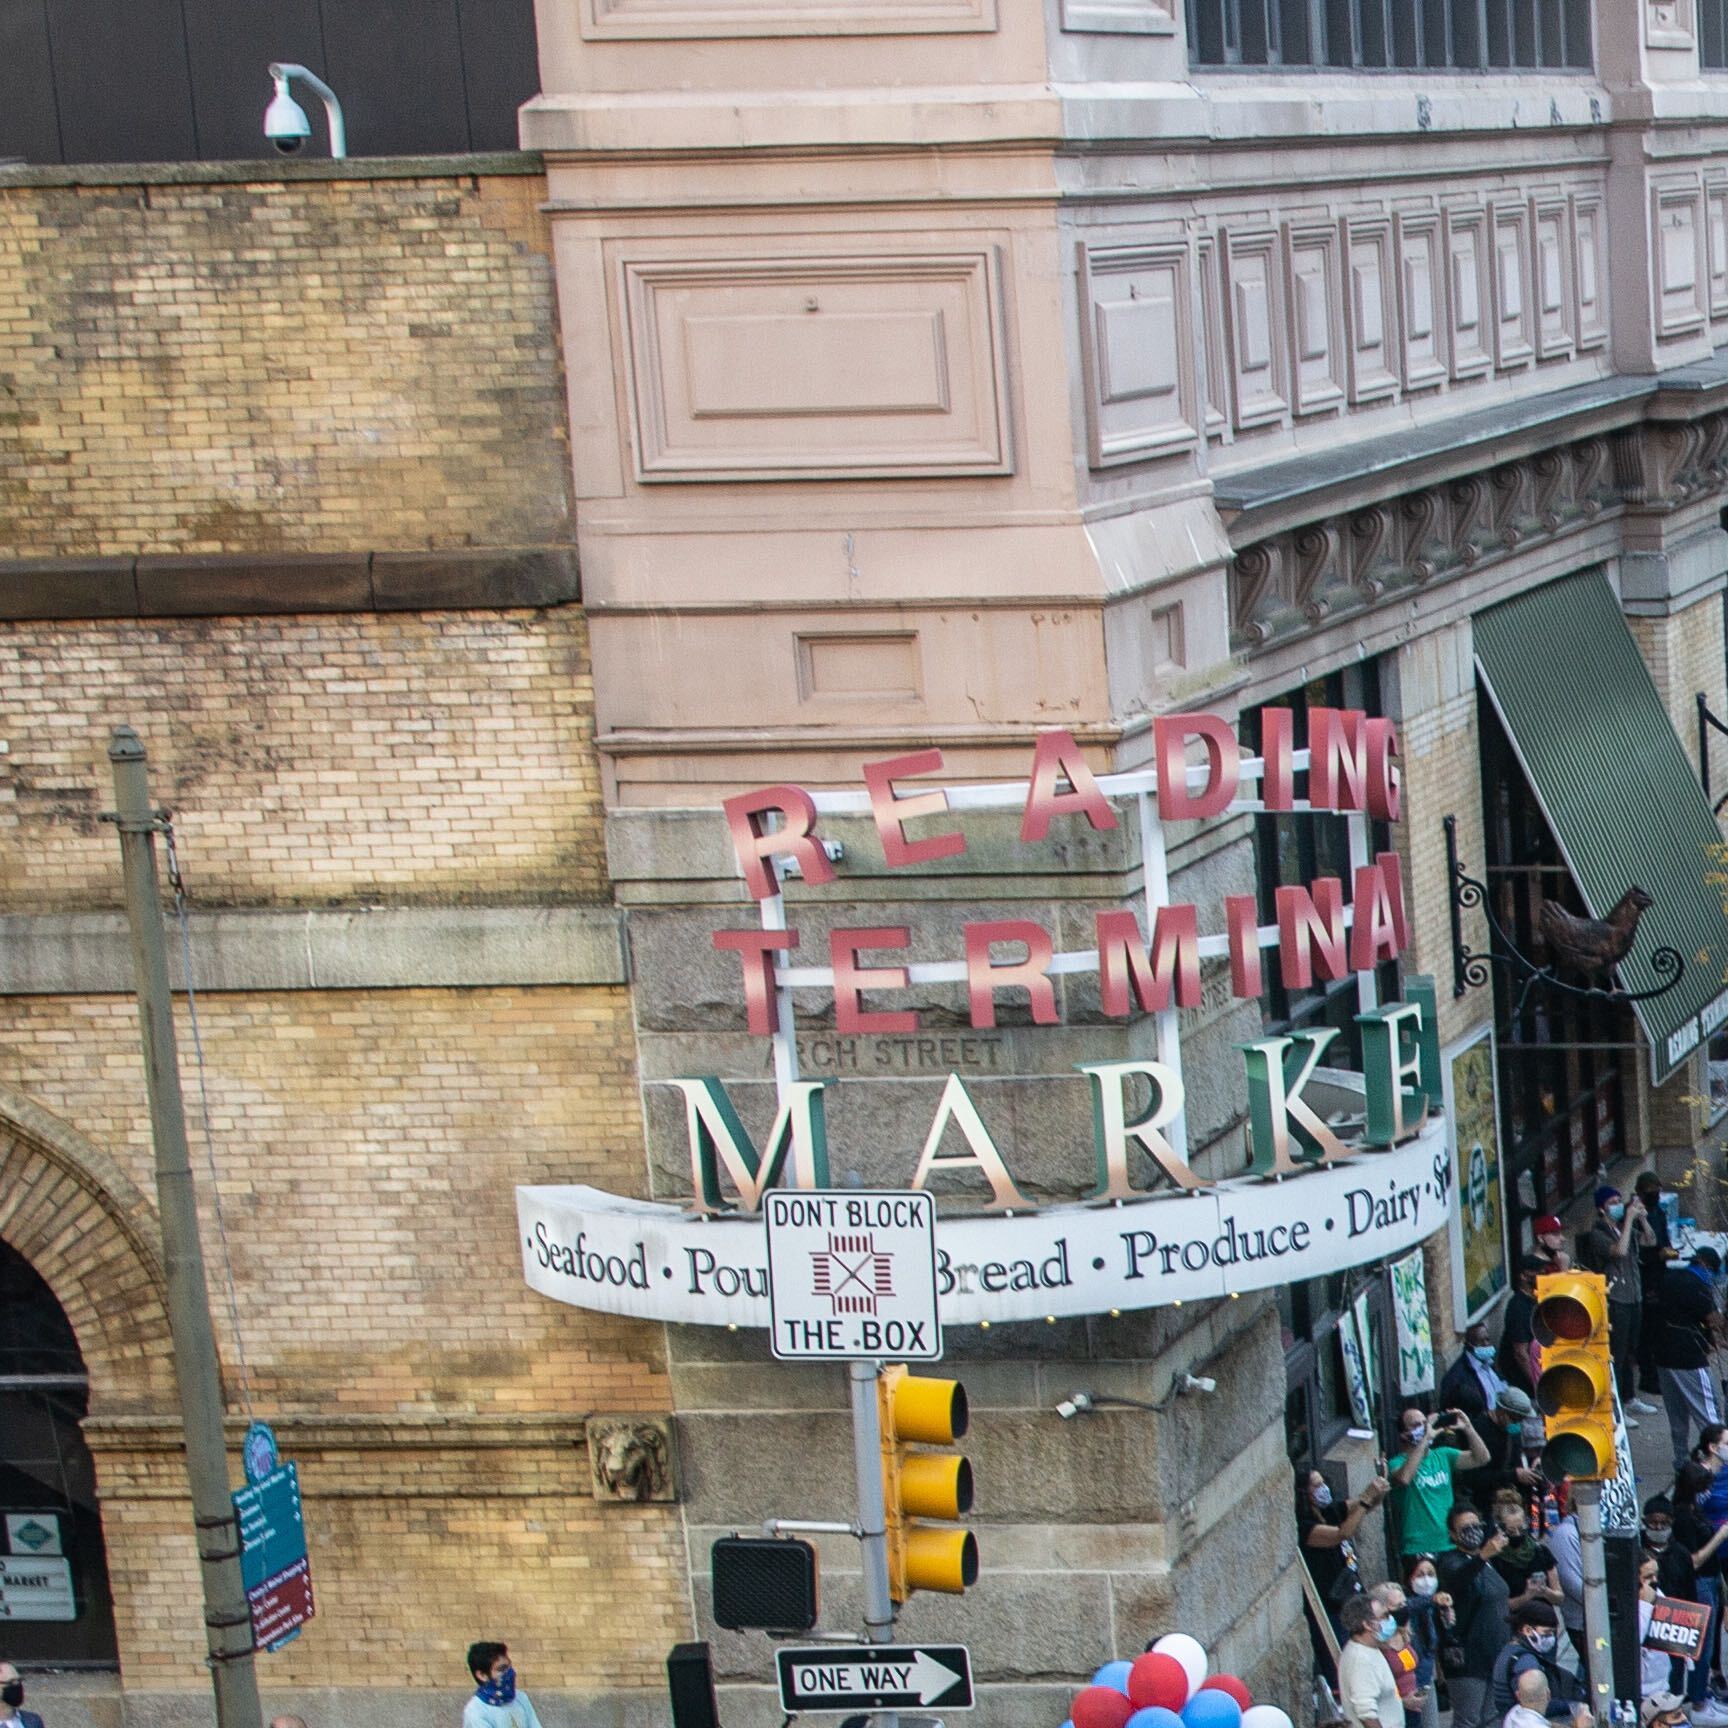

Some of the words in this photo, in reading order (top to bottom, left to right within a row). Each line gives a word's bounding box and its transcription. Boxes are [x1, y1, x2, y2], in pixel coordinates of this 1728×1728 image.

[722, 706, 1400, 902] READING
[874, 1036, 999, 1069] STREET
[849, 1200, 924, 1229] BLOCK
[535, 1222, 652, 1291] Seafood
[937, 1238, 1069, 1294] Bread
[1122, 1212, 1311, 1280] Produce
[1346, 1180, 1420, 1238] Dairy
[783, 1321, 844, 1351] THE
[862, 1320, 926, 1352] BOX
[4, 1574, 49, 1590] MARKET
[799, 1669, 853, 1693] ONE
[860, 1664, 912, 1691] WAY
